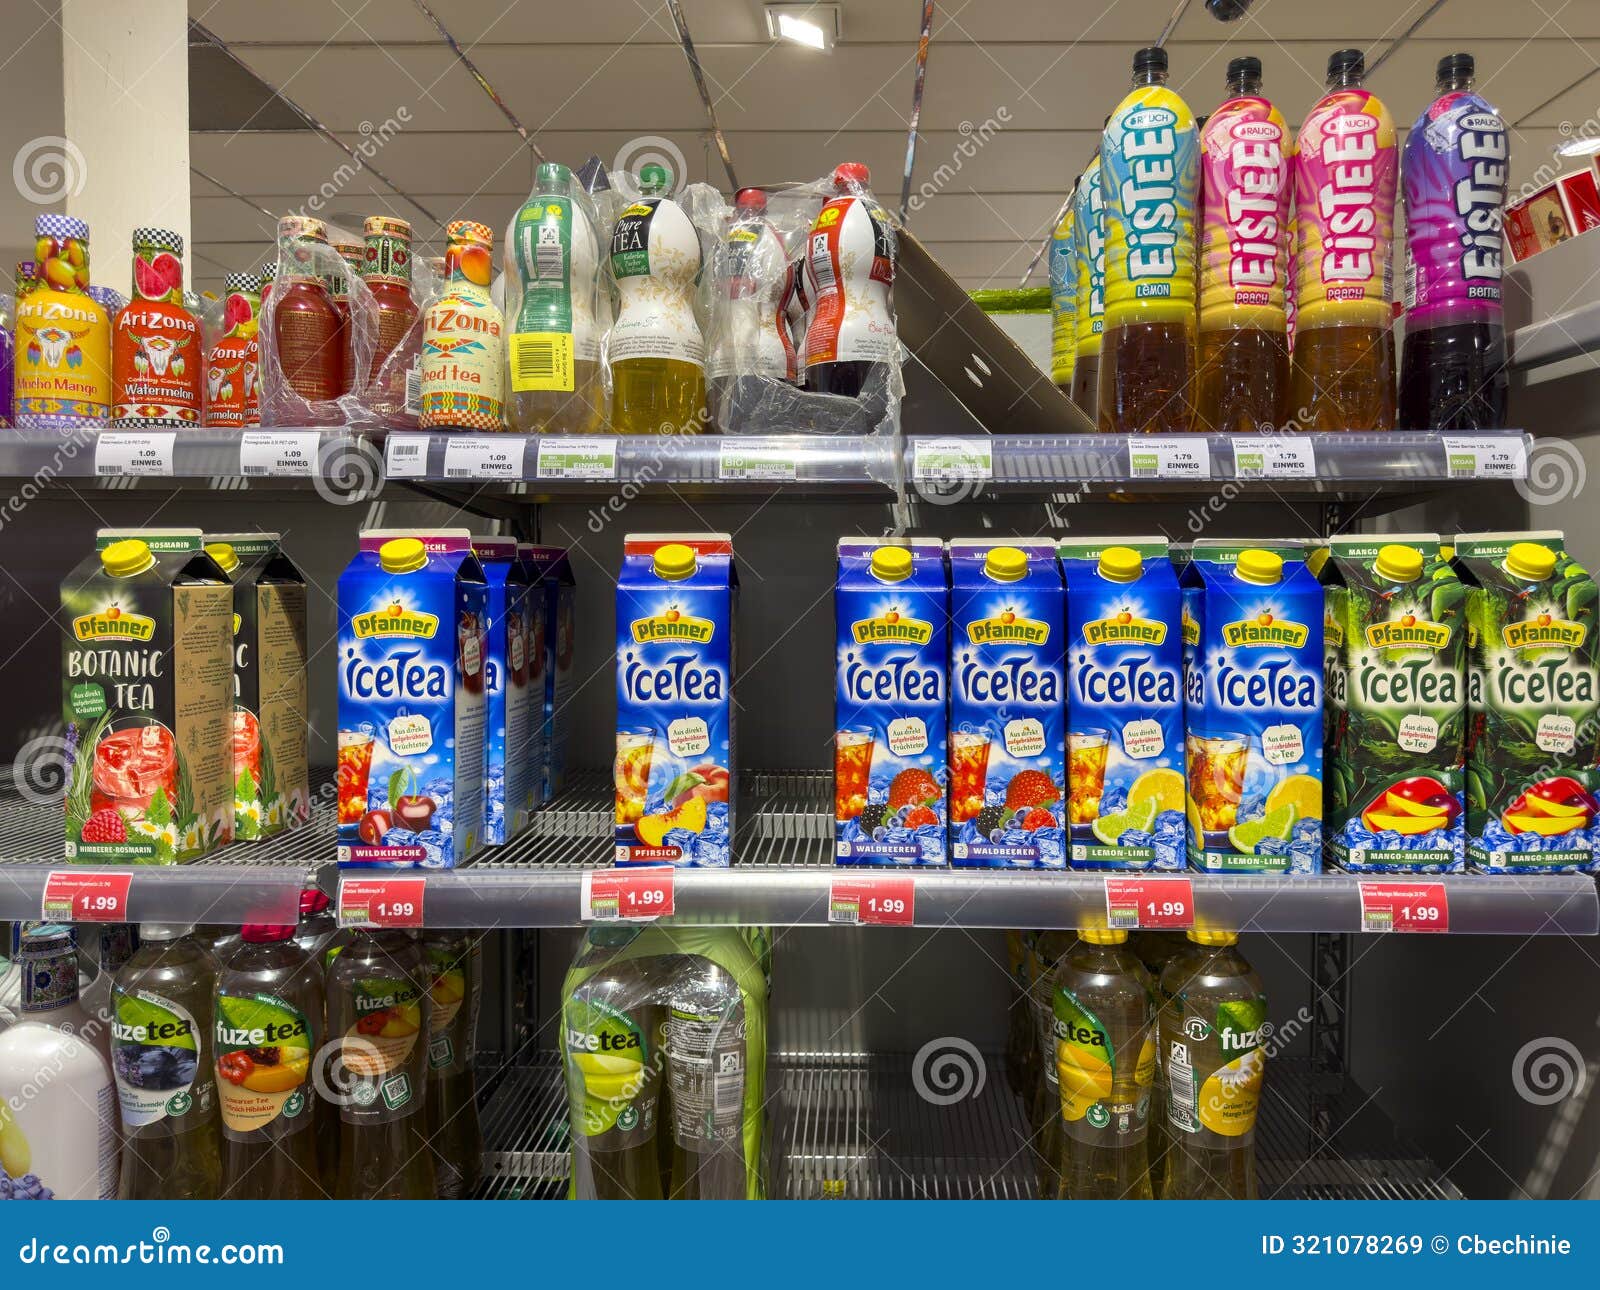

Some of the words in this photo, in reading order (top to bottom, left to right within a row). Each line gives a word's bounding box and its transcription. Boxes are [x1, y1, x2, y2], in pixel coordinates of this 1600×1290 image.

[1247, 127, 1276, 136] RAUCH
[616, 219, 642, 234] Pure
[613, 231, 643, 253] TEA
[424, 309, 500, 336] riZona
[451, 365, 481, 383] tea
[54, 378, 98, 397] Mango
[125, 384, 194, 401] Watermelon
[131, 459, 163, 467] EINWEG
[725, 457, 744, 467] BIO
[114, 683, 155, 710] TEA
[75, 705, 104, 714] Kräutern
[685, 726, 702, 734] direkt
[904, 728, 921, 736] direkt
[1404, 723, 1416, 731] Aus
[1417, 724, 1434, 733] direkt
[1541, 723, 1553, 731] Aus
[1554, 724, 1571, 732] direkt
[1009, 730, 1021, 738] Aus
[1021, 729, 1039, 737] direkt
[1139, 729, 1157, 737] direkt
[686, 742, 700, 750] Tee
[1414, 739, 1428, 748] Tee
[1552, 739, 1566, 748] Tee
[1280, 750, 1295, 758] Tee
[355, 849, 421, 857] WILDKIRSCHE
[1092, 849, 1150, 857] LEMON-LIME
[1370, 852, 1449, 860] MANGO-MARACUJA
[1511, 853, 1588, 862] MANGO-MARACUJA
[1227, 857, 1286, 865] LEMON-LIME
[627, 890, 664, 905] 1.99
[81, 896, 118, 910] 1.99
[868, 898, 905, 913] 1.99
[377, 903, 414, 916] 1.99
[1147, 902, 1184, 916] 1.99
[1401, 906, 1439, 920] 1.99
